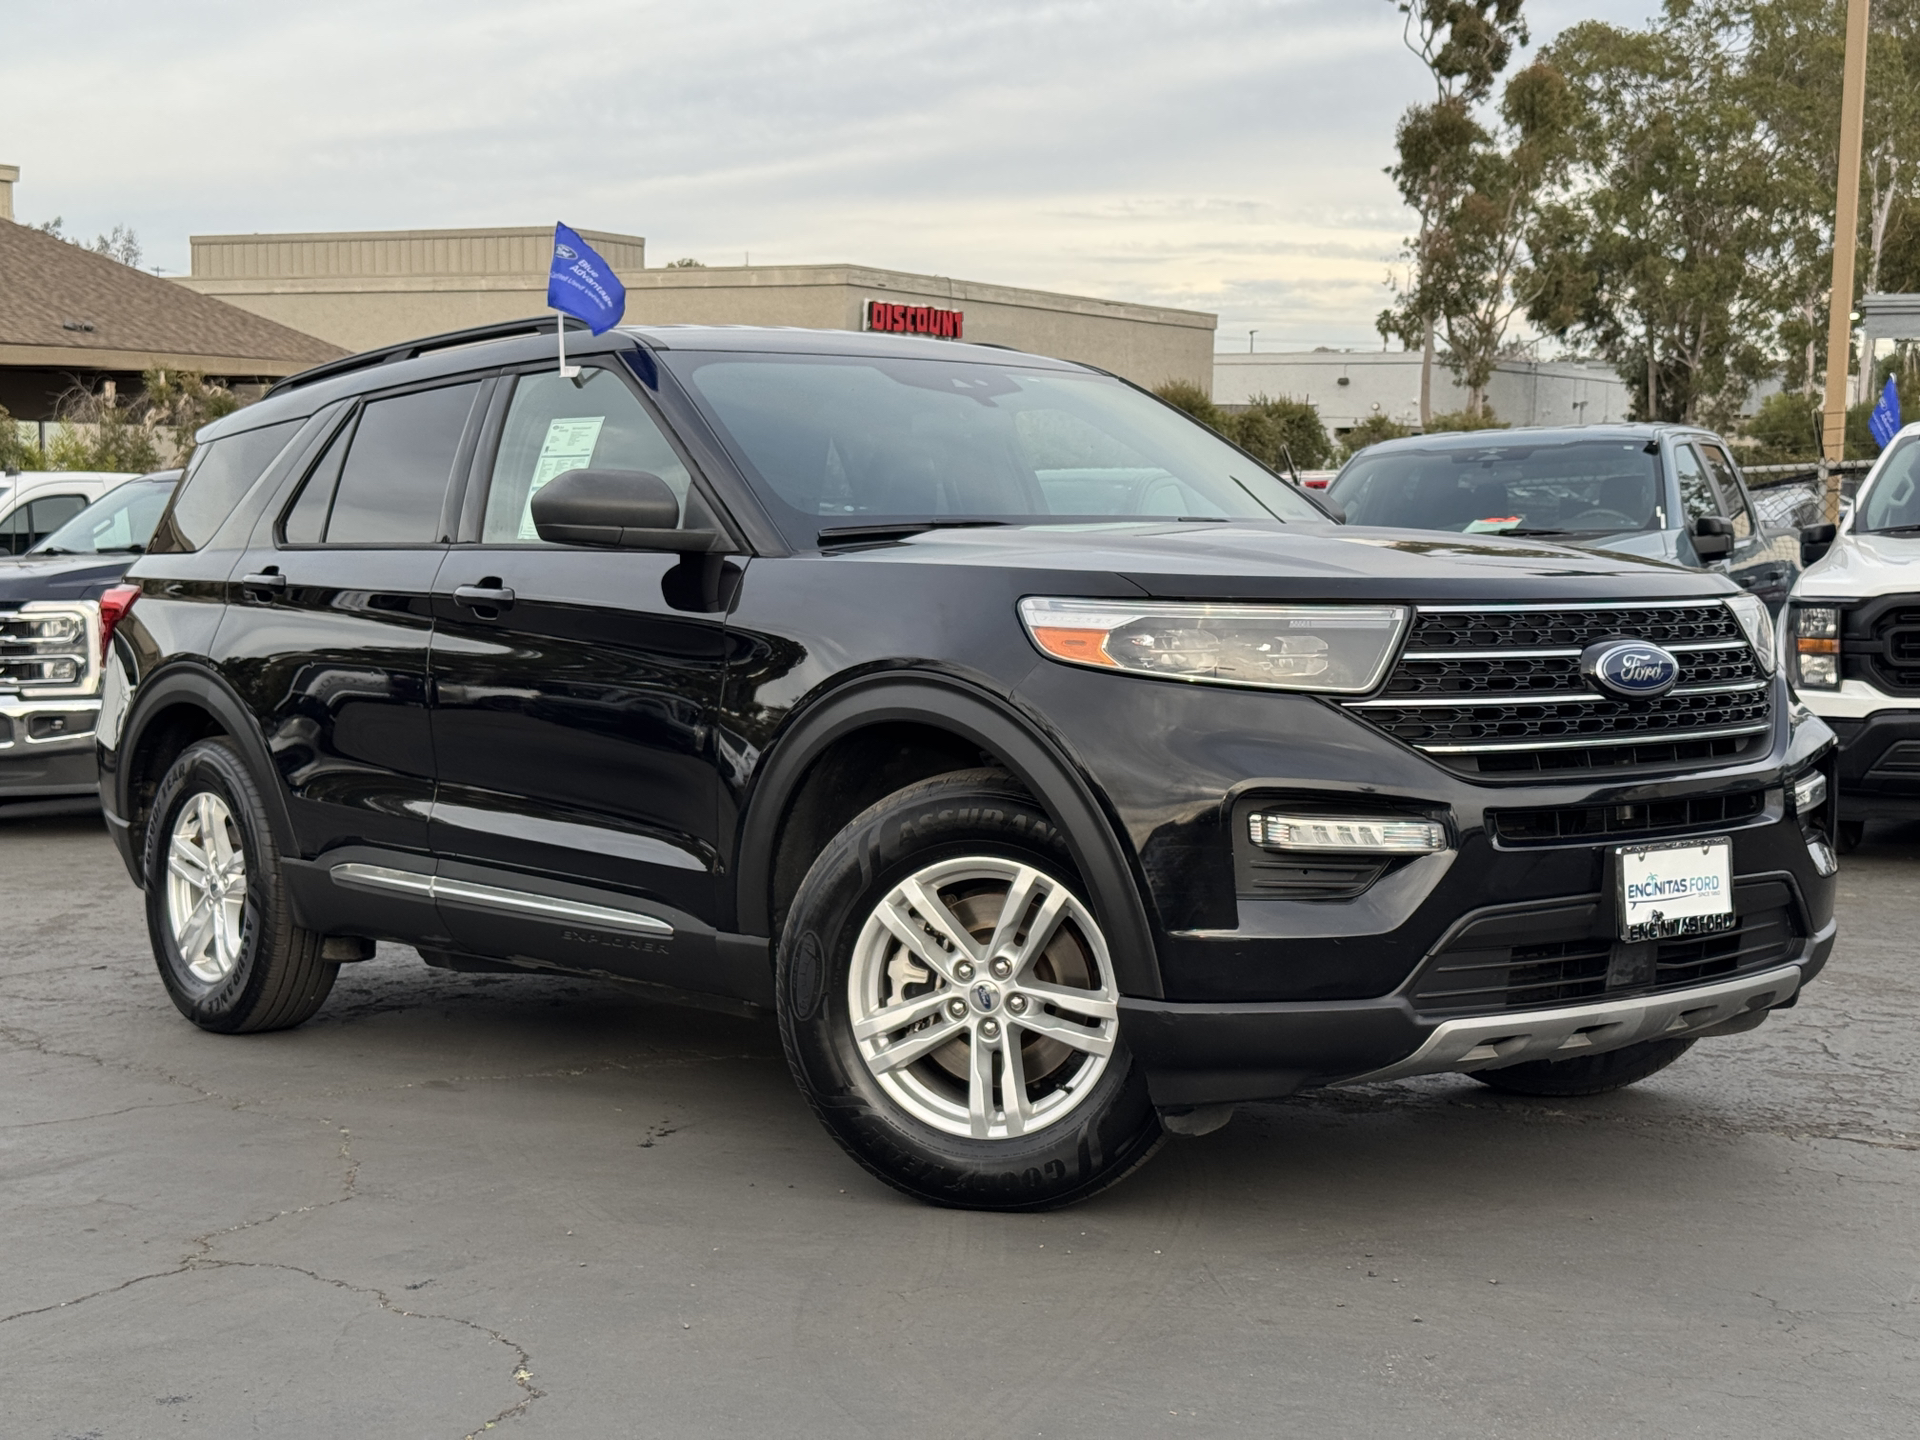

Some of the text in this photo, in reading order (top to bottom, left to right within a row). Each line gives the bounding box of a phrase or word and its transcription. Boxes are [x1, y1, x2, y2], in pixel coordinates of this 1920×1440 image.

[577, 259, 599, 278] Blue
[569, 264, 613, 308] Advantage
[872, 301, 963, 338] DISCOUNT
[1620, 653, 1664, 682] Ford
[1627, 875, 1719, 899] ENCINITAS FORD
[1629, 912, 1733, 941] ENCINITAS FORD
[562, 930, 669, 955] EXPLORER
